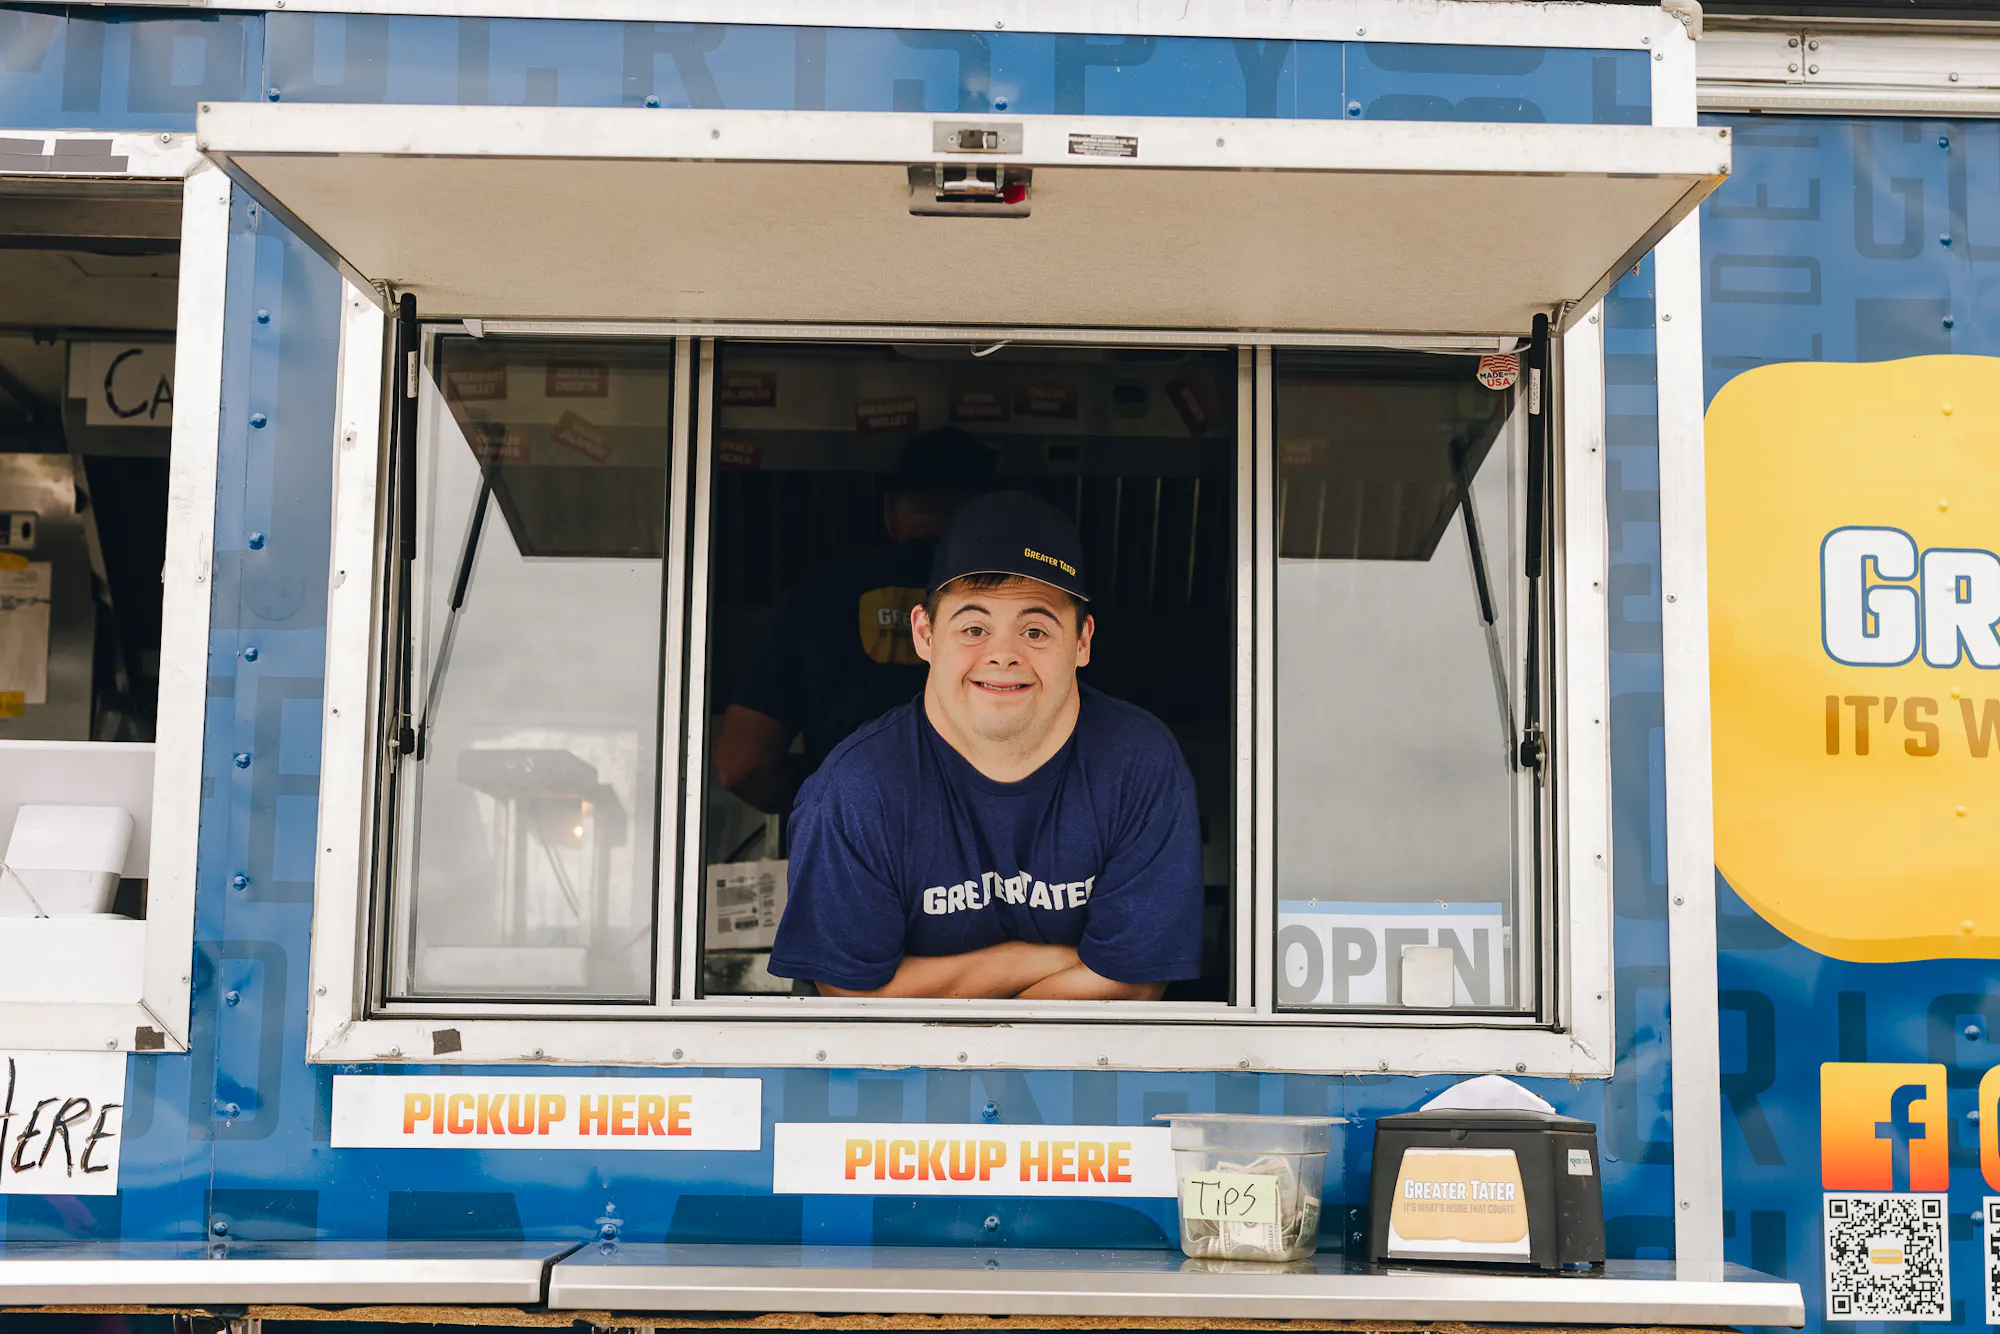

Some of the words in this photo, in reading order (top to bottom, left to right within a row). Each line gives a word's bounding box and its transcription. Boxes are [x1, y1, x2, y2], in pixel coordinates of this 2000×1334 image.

[1487, 378, 1510, 387] USA
[1024, 547, 1058, 567] GREATER
[1059, 560, 1077, 578] TATER
[1820, 525, 2000, 670] GR
[1825, 695, 1940, 757] IT'S
[923, 871, 1027, 915] GRETER
[1279, 925, 1491, 1005] OPEN
[403, 1093, 565, 1136] PICKUP
[578, 1095, 692, 1136] HERE
[845, 1139, 1006, 1181] PICKUP
[1020, 1141, 1132, 1183] HERE
[1404, 1178, 1466, 1200] GREATER
[1470, 1179, 1515, 1201] TATER
[1404, 1203, 1416, 1212] IT'S
[1418, 1203, 1444, 1213] WHAT'S
[1446, 1204, 1468, 1214] INSIDE
[1470, 1204, 1486, 1214] THAT
[1488, 1204, 1515, 1214] COUNTS
